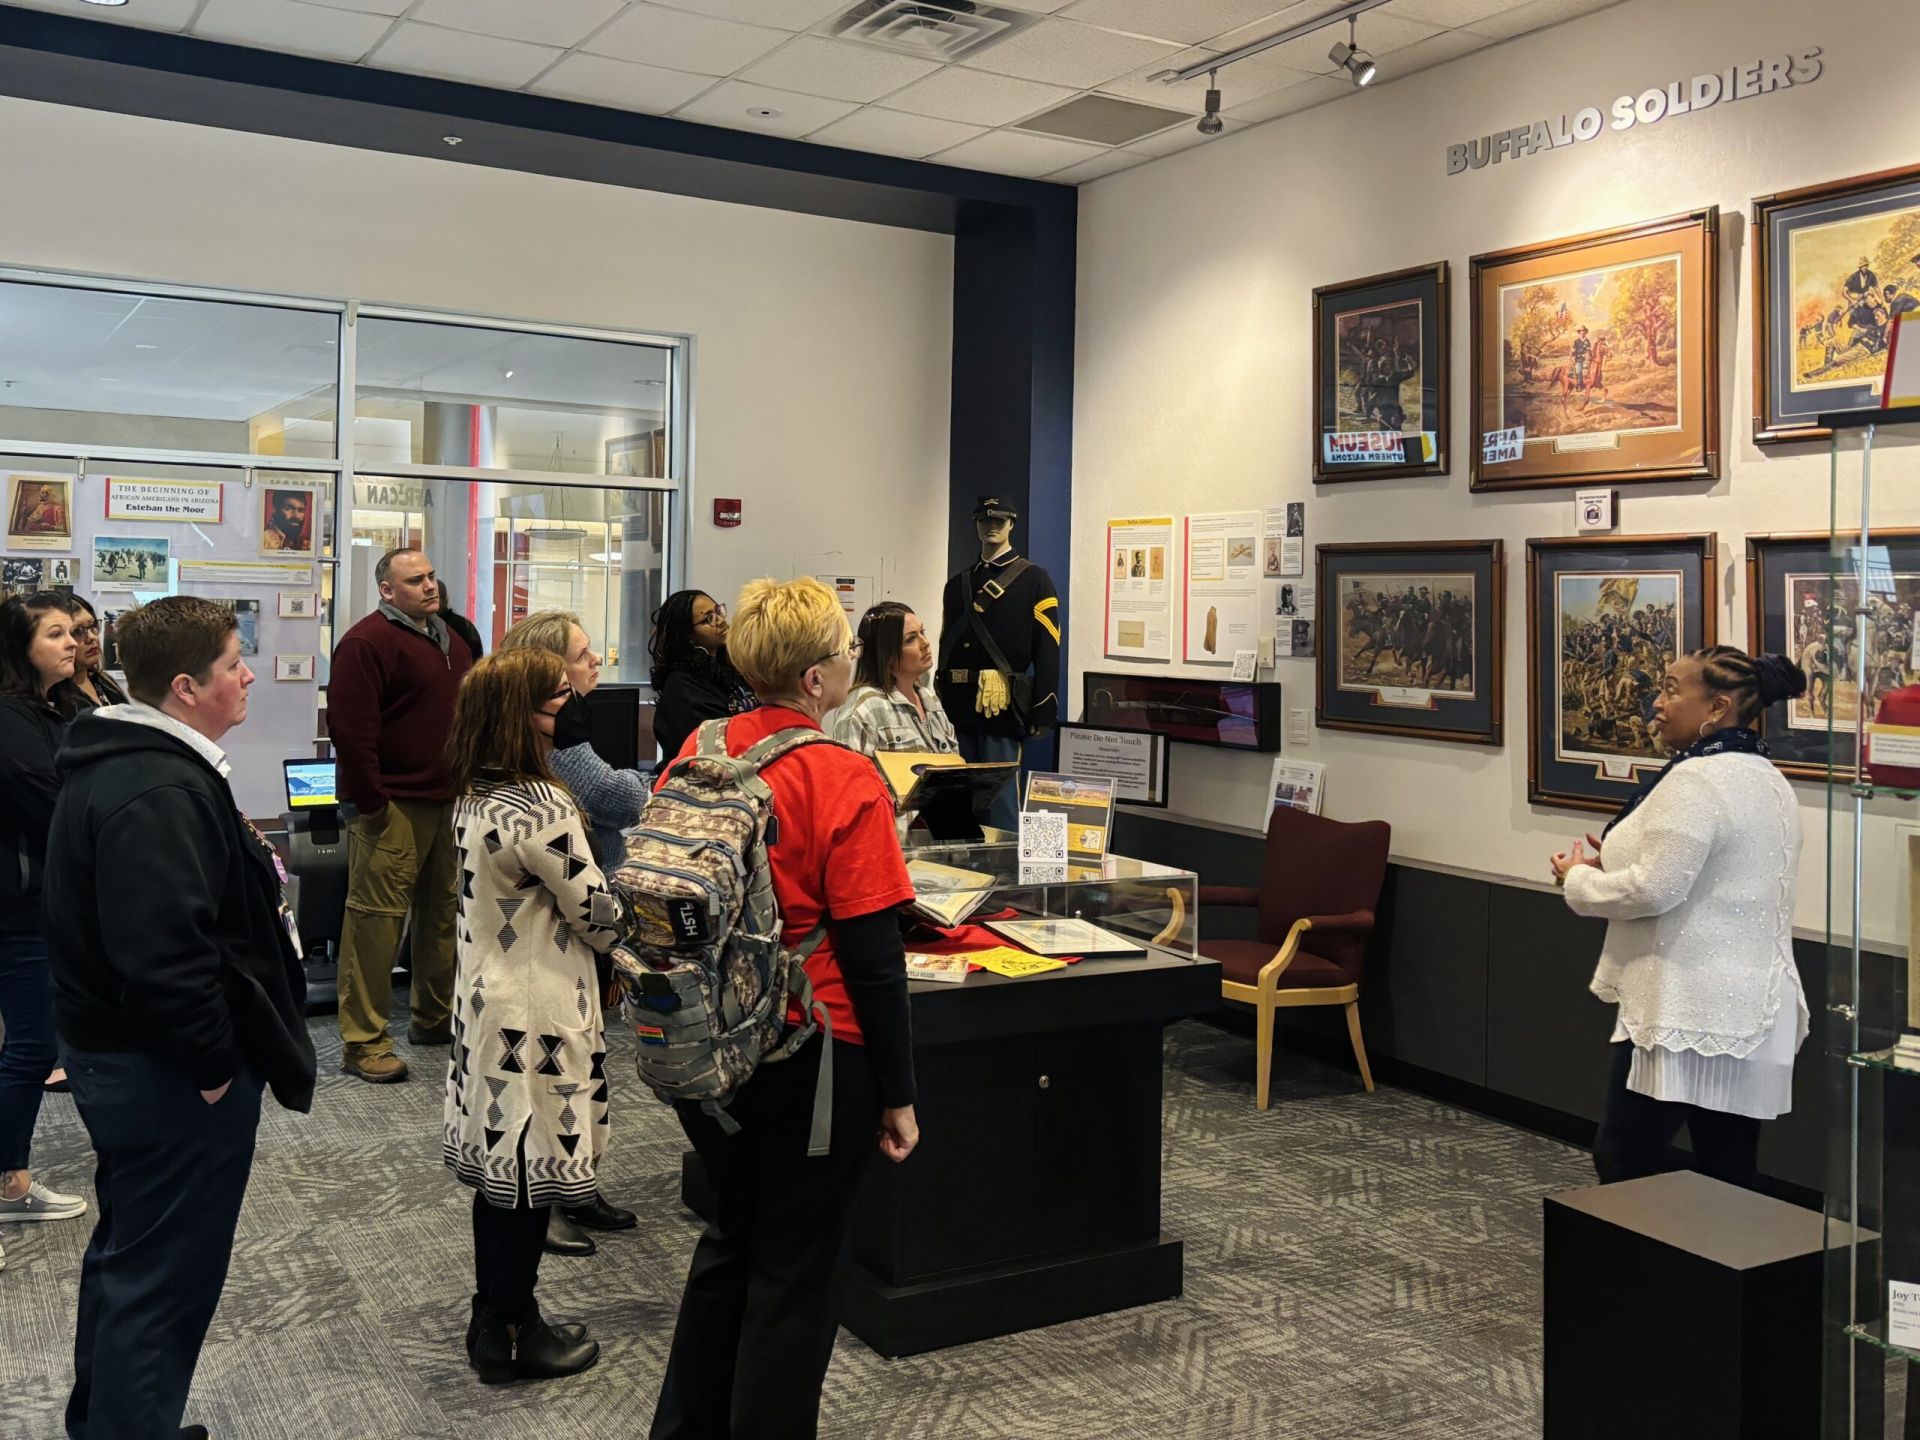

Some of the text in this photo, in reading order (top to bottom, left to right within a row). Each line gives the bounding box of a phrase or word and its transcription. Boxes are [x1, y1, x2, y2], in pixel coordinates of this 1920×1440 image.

[1446, 46, 1823, 175] BUFFALO SOLDIERS
[118, 485, 137, 493] THE
[140, 486, 194, 495] BEGINNING
[126, 503, 205, 513] Esteban the Moor
[1070, 731, 1142, 746] Please Do Not Touch
[1892, 1290, 1909, 1301] Joy
